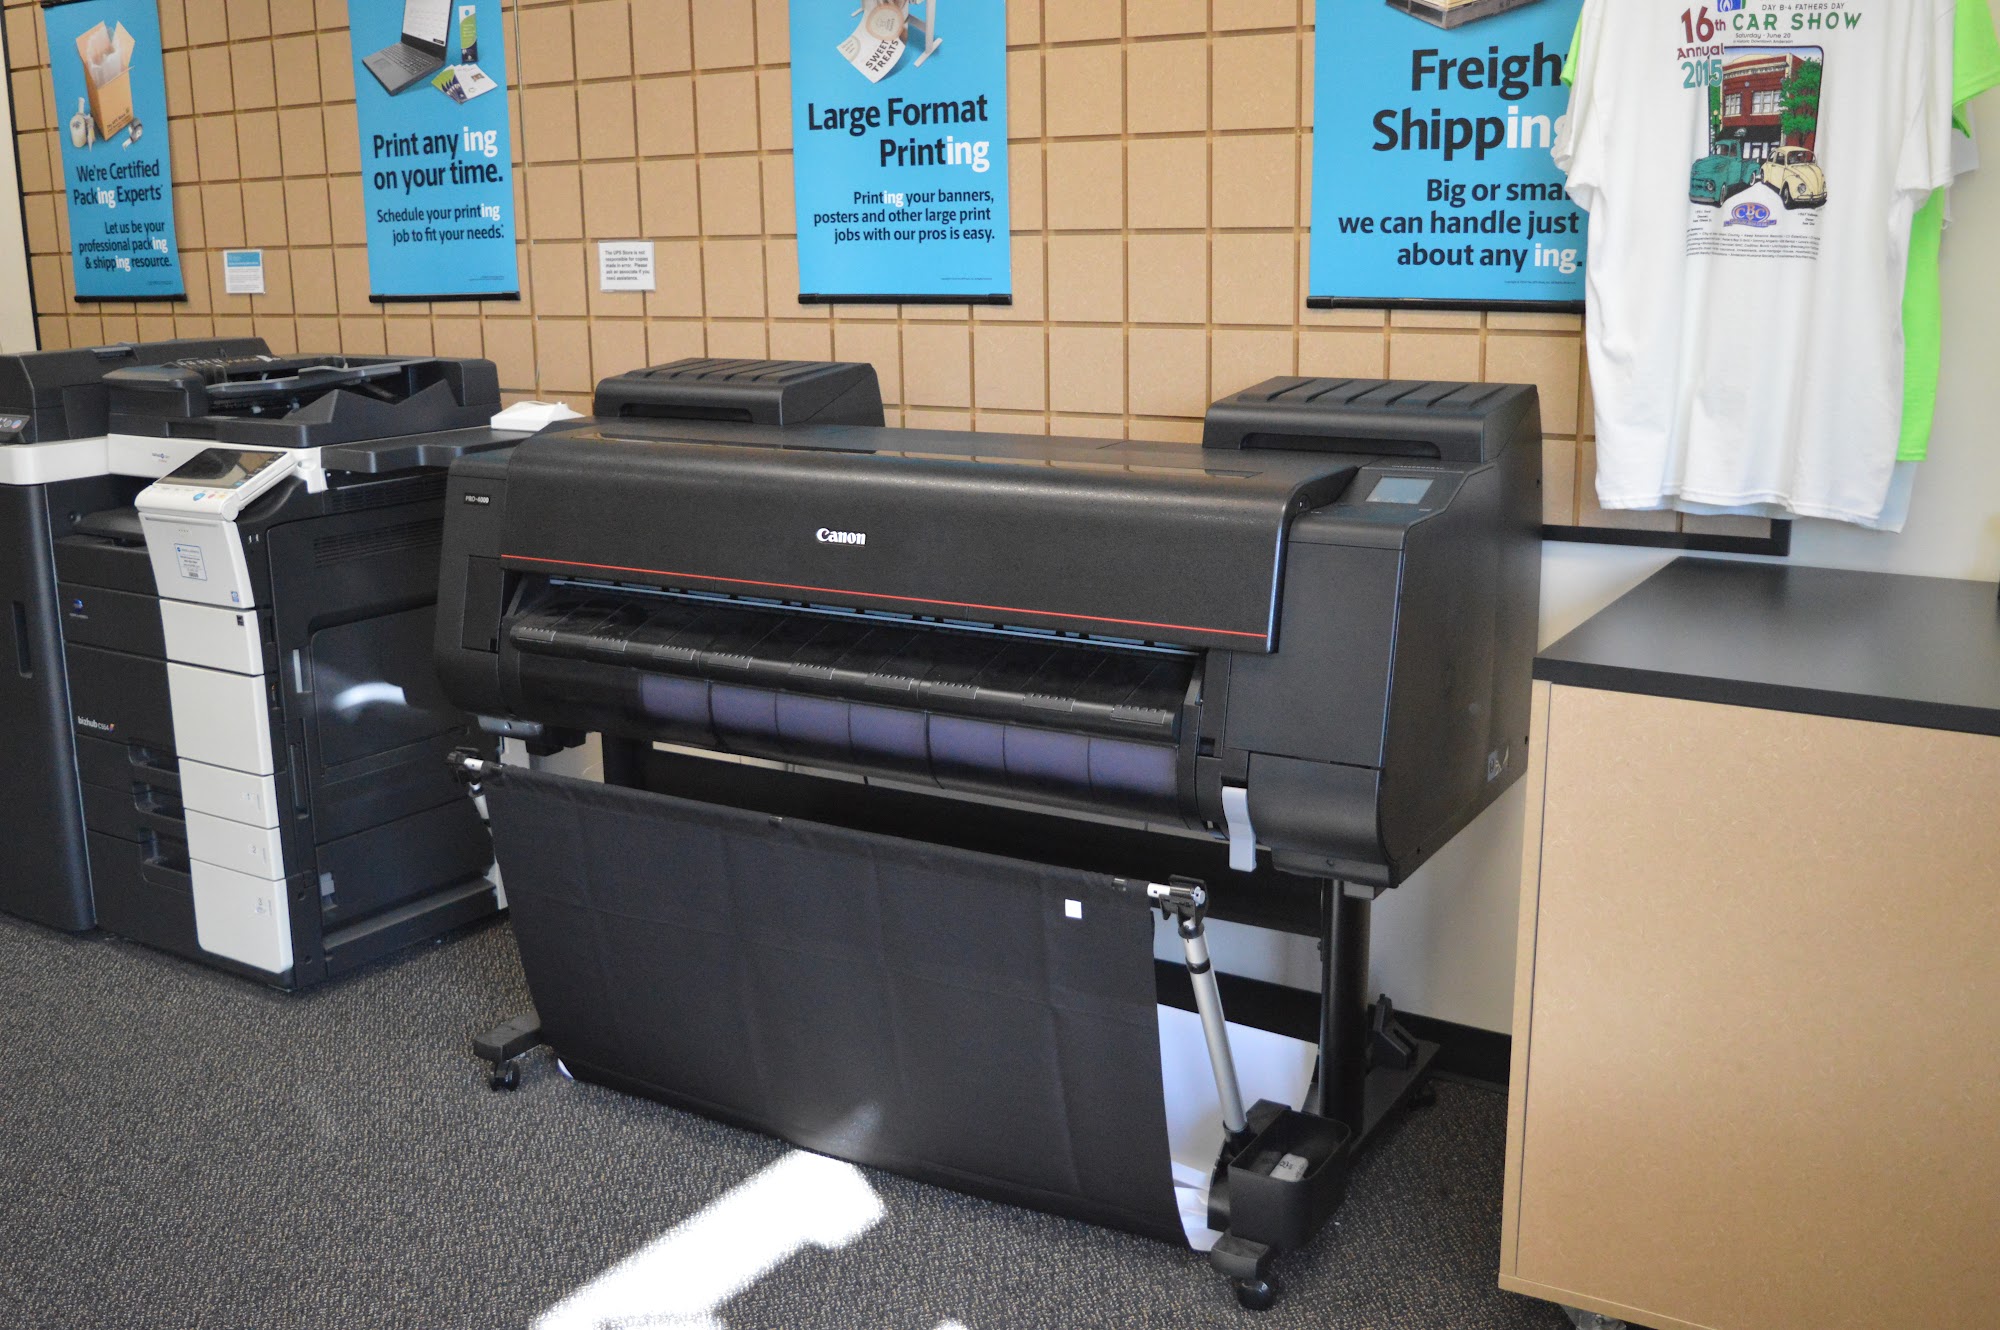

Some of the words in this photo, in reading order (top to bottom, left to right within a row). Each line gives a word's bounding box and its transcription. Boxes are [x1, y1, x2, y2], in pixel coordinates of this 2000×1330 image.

[1732, 13, 1778, 31] CAR
[1790, 12, 1862, 30] SHOW
[866, 40, 889, 68] SWEET
[872, 40, 898, 73] TREATS
[1677, 43, 1724, 60] Annual
[1412, 41, 1568, 100] Freigh
[1681, 59, 1722, 89] 2015
[808, 102, 880, 136] Large
[887, 94, 988, 126] Format
[373, 132, 419, 158] Print
[422, 133, 459, 160] any
[463, 126, 498, 158] ing
[880, 136, 990, 173] Printing
[76, 164, 107, 182] We're
[110, 159, 160, 180] Certified
[373, 170, 398, 190] on
[401, 167, 446, 195] your
[450, 160, 504, 185] time.
[73, 187, 116, 208] Packing
[853, 190, 904, 208] Printing
[905, 192, 935, 208] your
[938, 189, 994, 204] banners,
[1427, 178, 1466, 208] Big
[1472, 182, 1500, 201] or
[377, 207, 424, 223] Schedule
[426, 209, 452, 224] your
[454, 203, 500, 222] printing
[813, 210, 859, 227] posters
[861, 210, 885, 222] and
[888, 209, 923, 222] other
[925, 209, 956, 224] large
[959, 208, 991, 224] print
[104, 222, 117, 234] Let
[120, 223, 130, 234] us
[132, 220, 142, 233] be
[144, 222, 165, 236] your
[1338, 216, 1374, 234] we
[1380, 216, 1423, 234] can
[1430, 209, 1522, 234] handle
[1526, 210, 1580, 240] just
[79, 238, 130, 255] professional
[132, 237, 168, 253] packing
[393, 227, 410, 246] job
[412, 230, 423, 242] to
[424, 227, 437, 241] fit
[439, 229, 464, 244] your
[834, 228, 861, 244] jobs
[863, 227, 890, 241] with
[893, 229, 915, 240] our
[918, 229, 947, 244] pros
[949, 228, 960, 240] is
[962, 229, 995, 243] easy.
[85, 257, 92, 269] &
[93, 256, 131, 272] shipping
[131, 256, 172, 268] resource.
[1397, 242, 1474, 266] about
[1480, 248, 1528, 272] any
[1534, 242, 1583, 274] ing.
[816, 528, 866, 545] Canon
[78, 716, 97, 728] bizhub
